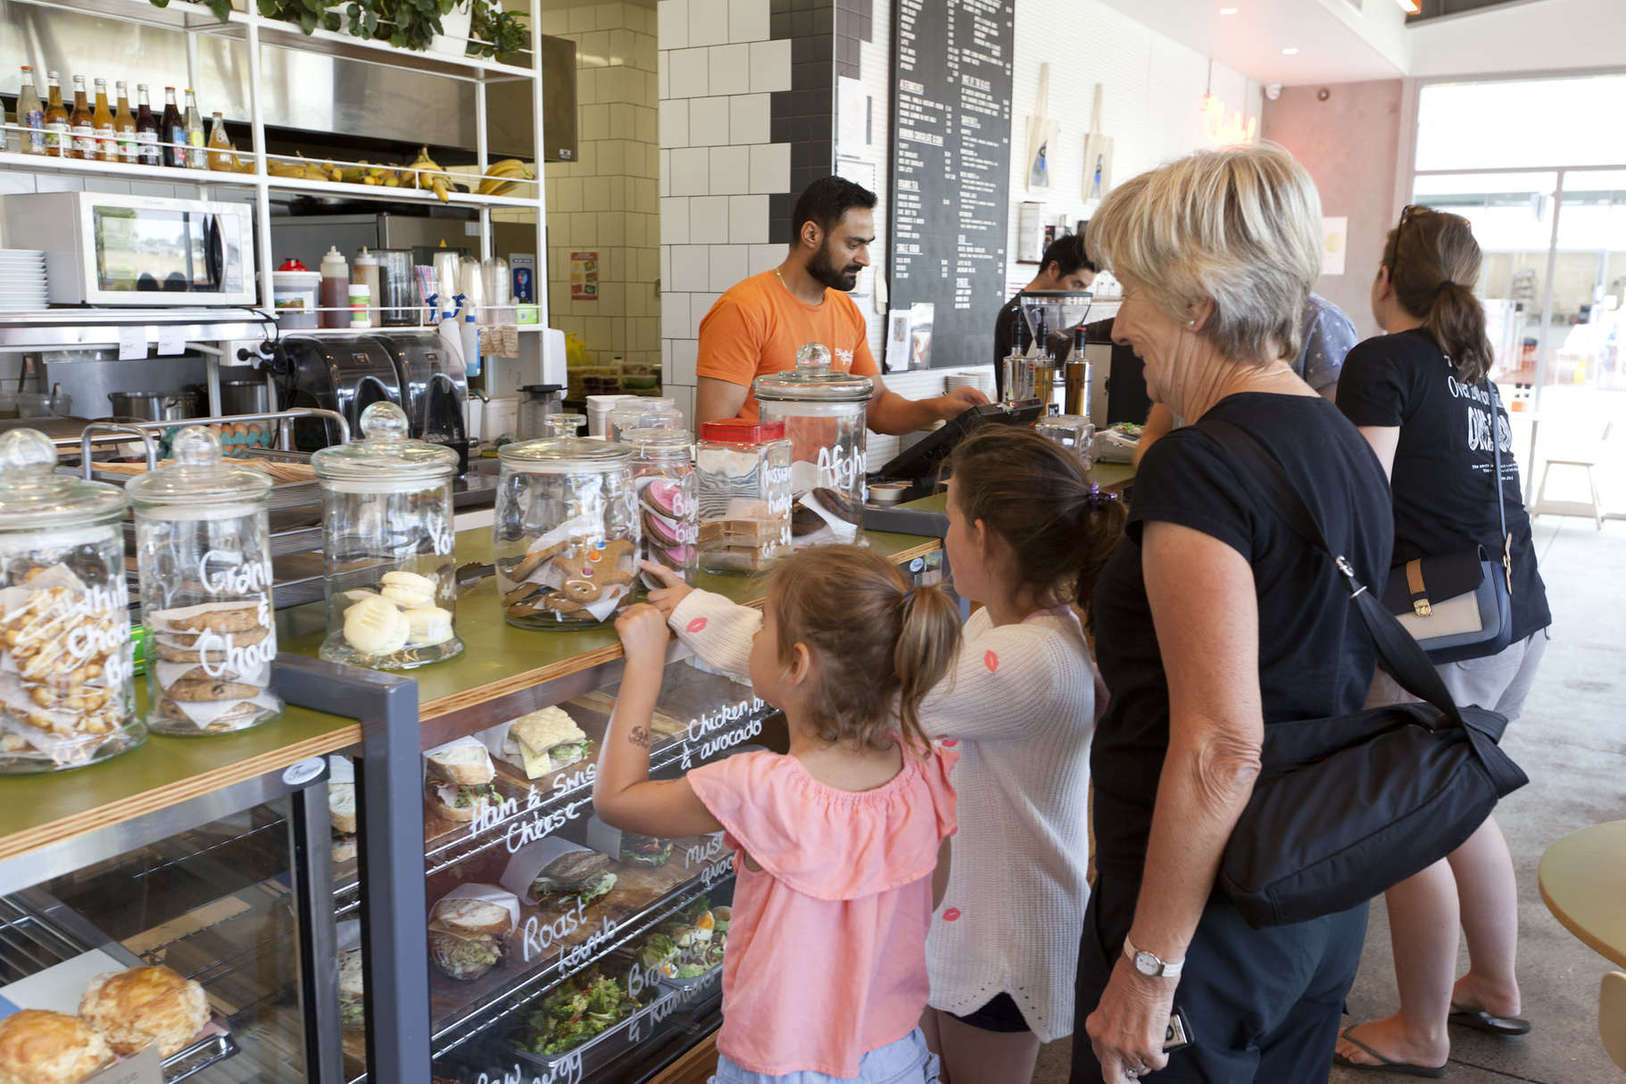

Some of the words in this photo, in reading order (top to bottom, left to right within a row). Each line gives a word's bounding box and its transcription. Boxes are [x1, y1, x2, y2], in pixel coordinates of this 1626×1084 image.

[700, 718, 762, 760] avocado
[469, 796, 518, 840] Ham
[505, 801, 581, 855] Cheese
[523, 895, 588, 962] Roast
